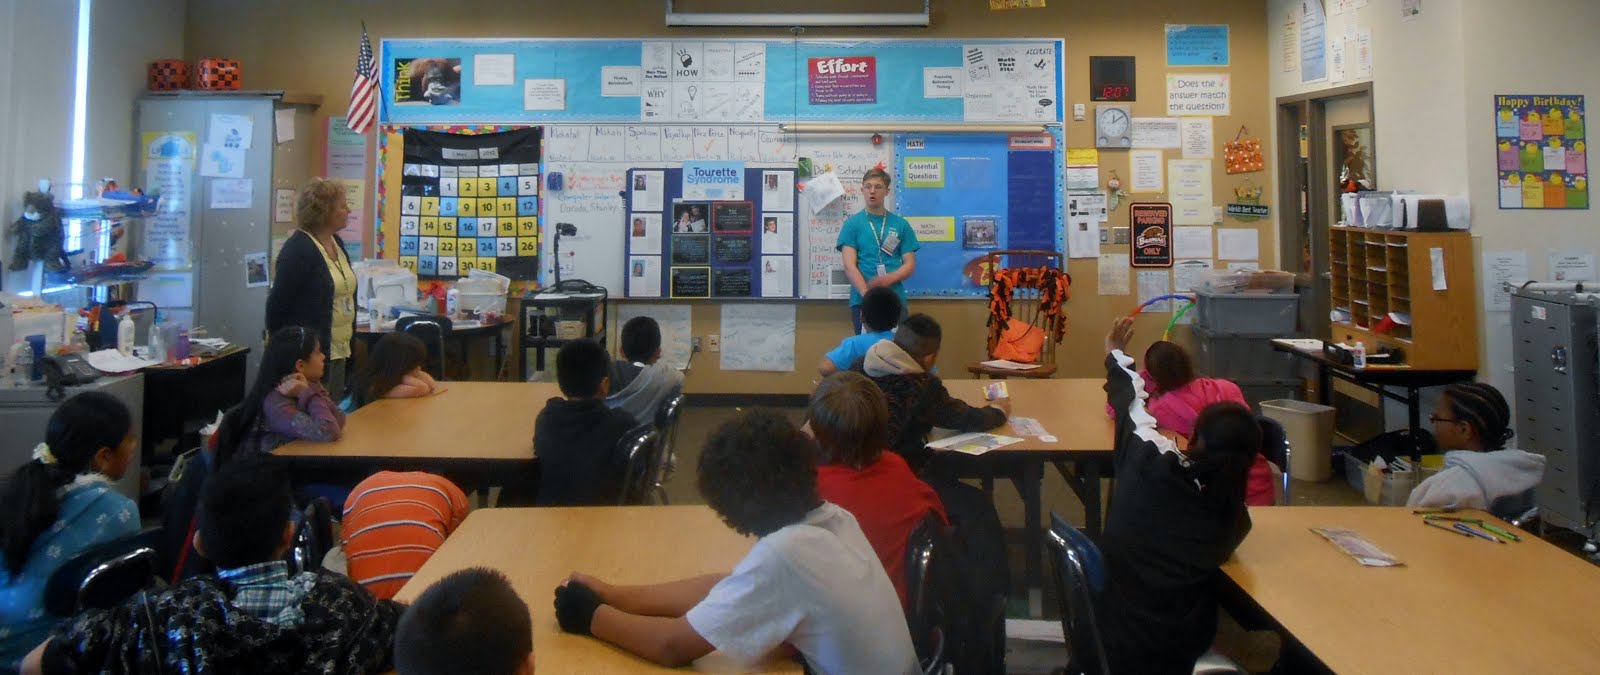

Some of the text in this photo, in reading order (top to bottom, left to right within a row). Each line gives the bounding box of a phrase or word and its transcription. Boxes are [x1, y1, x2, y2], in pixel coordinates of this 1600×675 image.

[816, 58, 868, 74] Effort
[676, 69, 699, 77] HOW
[1178, 80, 1216, 88] Does the
[647, 90, 665, 98] WHY
[1169, 91, 1227, 100] answer match
[1169, 102, 1184, 111] the
[1498, 97, 1582, 108] Happy Birthday!
[906, 139, 924, 148] MATH
[693, 167, 737, 177] Tourette
[687, 175, 740, 185] Syndrome
[465, 183, 471, 191] 2
[485, 183, 490, 191] 3
[504, 182, 510, 190] 4
[524, 182, 530, 190] 5
[408, 202, 533, 212] 6 7 8 9 10 11 12
[1134, 210, 1168, 218] RESERVED
[405, 221, 533, 231] 13 14 15 16 17 18 19
[403, 241, 534, 251] 20 21 22 23 24 25 26
[421, 260, 433, 268] 28
[442, 262, 454, 270] 29
[462, 262, 474, 271] 30
[482, 262, 492, 270] 31
